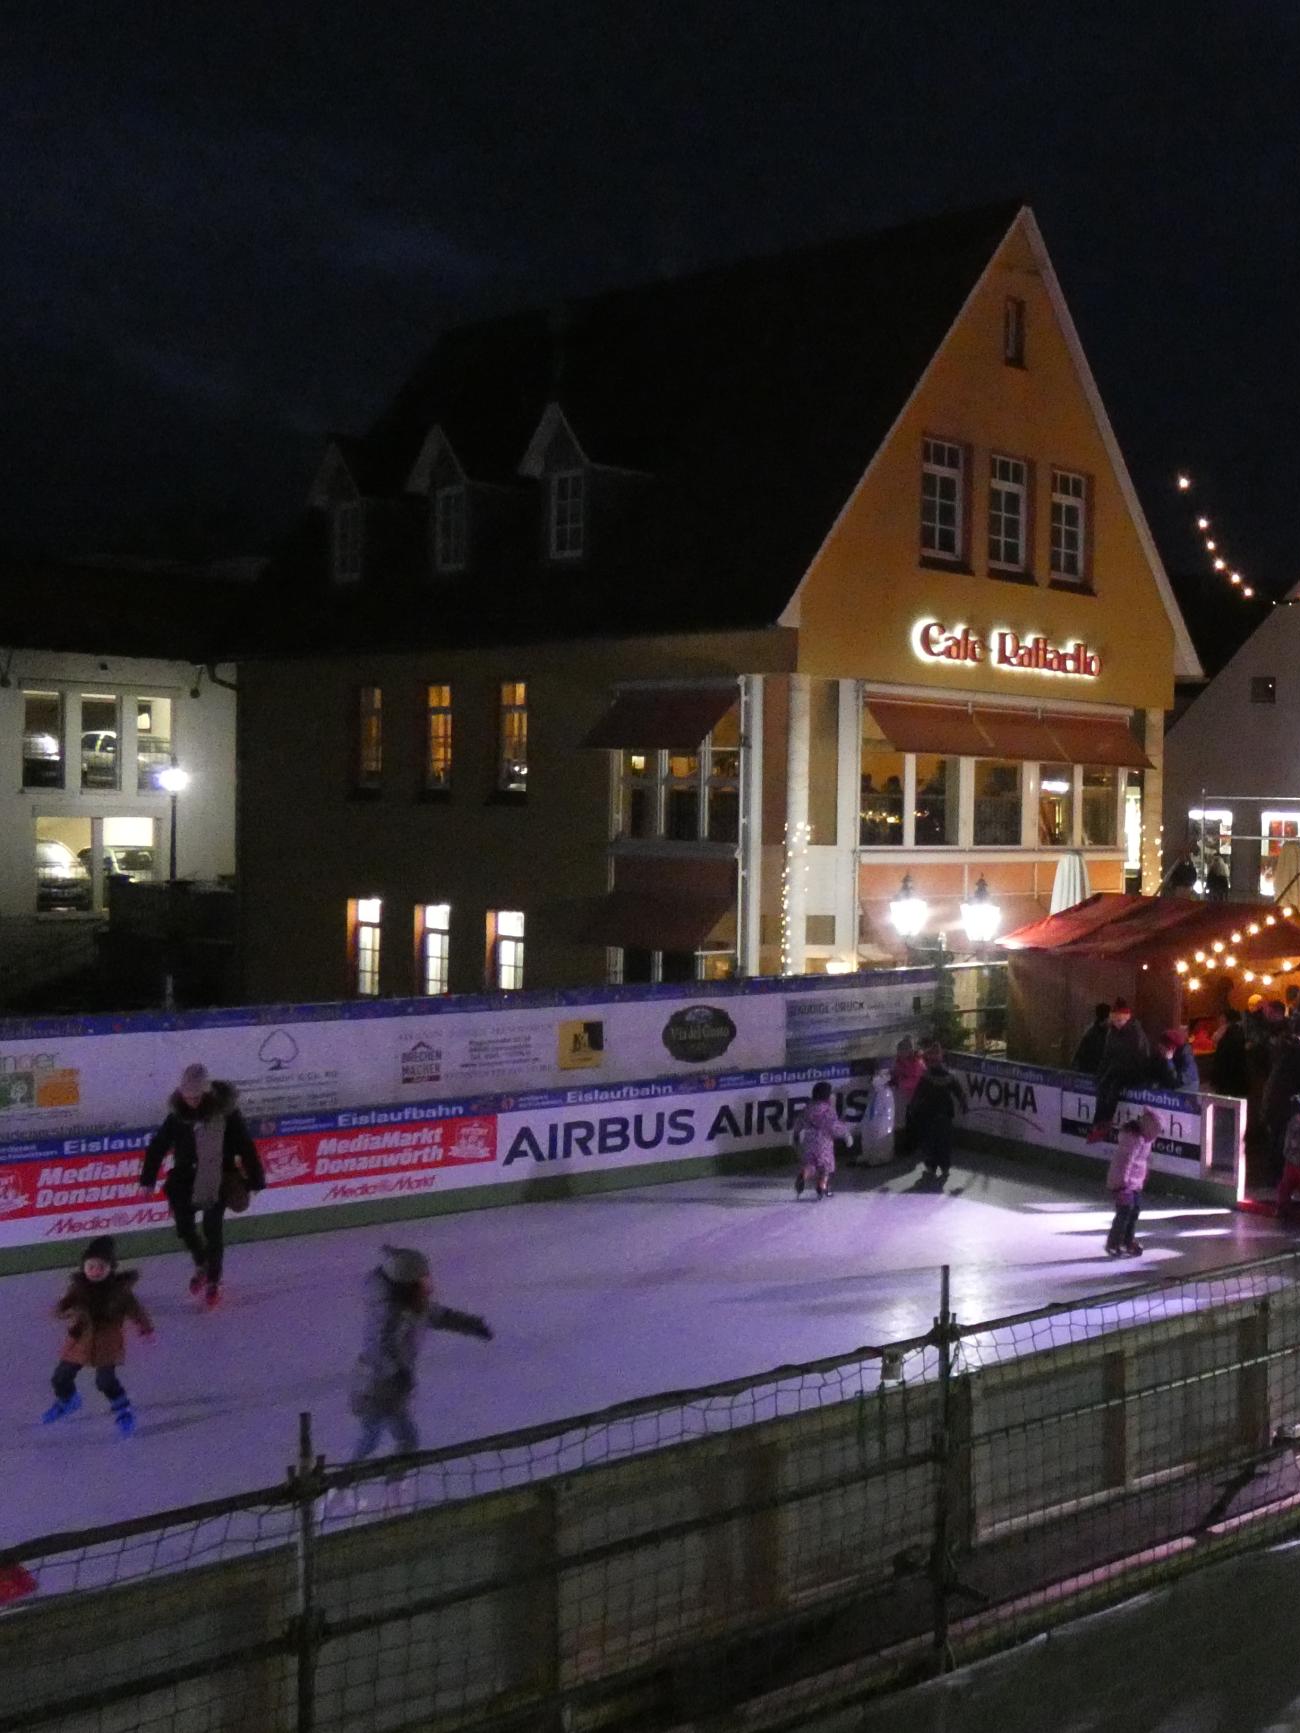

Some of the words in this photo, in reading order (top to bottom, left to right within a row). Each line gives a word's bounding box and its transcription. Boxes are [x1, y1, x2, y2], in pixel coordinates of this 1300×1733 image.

[759, 1065, 851, 1085] Eislaufbahn
[566, 1081, 673, 1104] Eislaufbahn
[965, 1073, 1038, 1114] WOHA
[337, 1103, 465, 1127] Eislaufbahn
[63, 1133, 152, 1156] Eislauf
[315, 1127, 444, 1157] MediaMarkt
[502, 1108, 696, 1167] AIRBUS
[314, 1145, 444, 1177] Donauwörth
